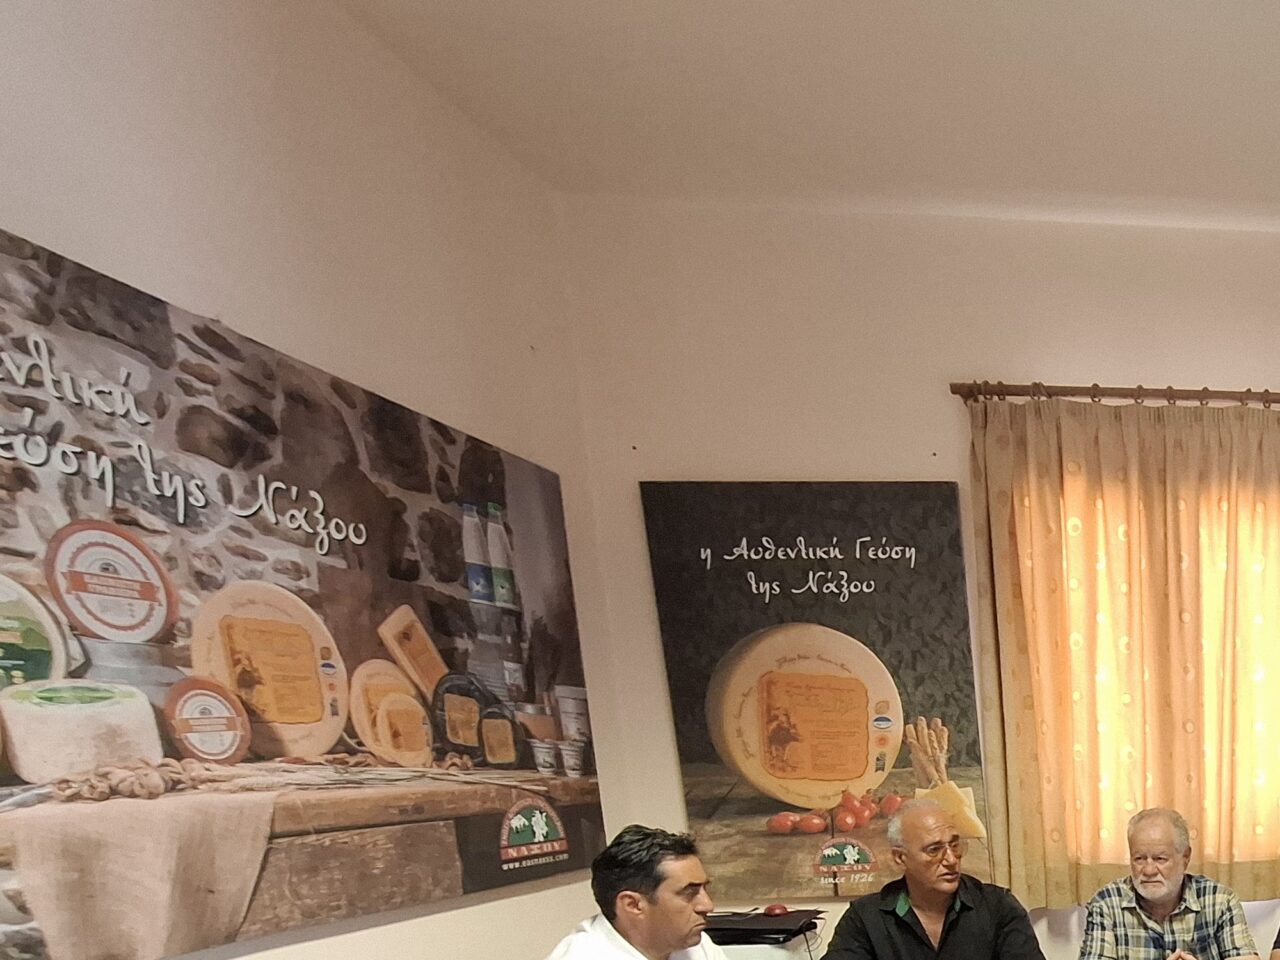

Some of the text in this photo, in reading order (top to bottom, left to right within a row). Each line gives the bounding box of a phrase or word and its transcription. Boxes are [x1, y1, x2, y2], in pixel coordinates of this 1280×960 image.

[0, 335, 150, 424] ντική
[227, 474, 367, 556] Νάξου
[700, 536, 916, 570] η Αυθεντική Γεύση
[747, 570, 876, 603] της Νάξου
[850, 873, 874, 883] 1926
